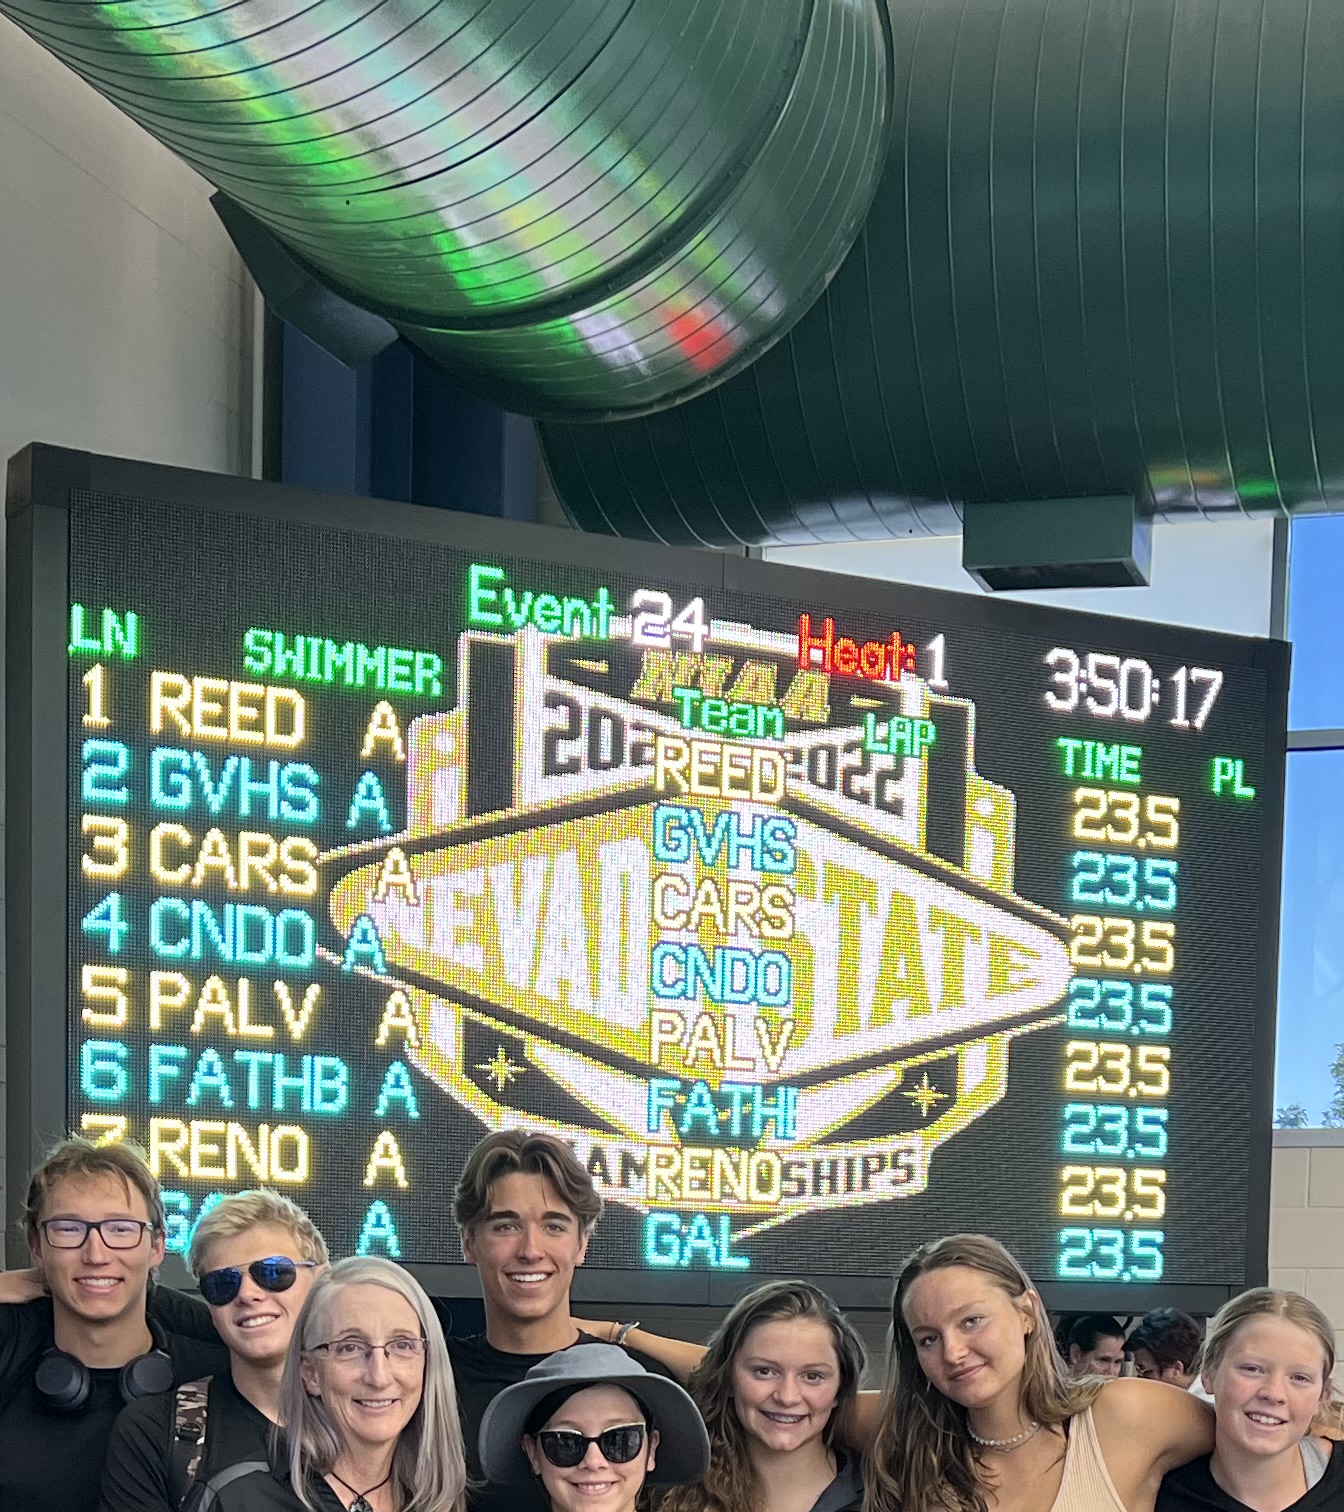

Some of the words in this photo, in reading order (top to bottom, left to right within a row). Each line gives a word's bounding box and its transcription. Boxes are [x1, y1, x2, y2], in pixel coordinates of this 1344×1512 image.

[68, 603, 139, 658] LN
[243, 627, 443, 697] SWIMMER
[468, 563, 614, 640] Event
[630, 588, 710, 653] 24
[925, 633, 950, 690] 1
[81, 663, 112, 729] 1
[149, 670, 307, 750] REED
[360, 700, 406, 761] A
[672, 686, 786, 740] Team
[863, 710, 937, 758] LAP
[81, 738, 131, 805] 2
[149, 746, 320, 824] GVHS
[346, 769, 392, 832] A
[655, 734, 787, 803] REED
[1056, 736, 1144, 786] TIME
[1210, 756, 1256, 800] PL
[653, 803, 798, 874] GVHS
[1071, 786, 1181, 850] 23.5
[81, 814, 129, 879] 3
[149, 822, 318, 897] CARS
[374, 847, 419, 905] A
[1069, 850, 1178, 911] 23.5
[81, 891, 129, 955] 4
[149, 896, 316, 969] CNDO
[341, 913, 387, 974] A
[652, 872, 797, 942] CARS
[651, 941, 793, 1006] CNDO
[1068, 914, 1175, 974] 23.5
[80, 964, 128, 1028] 5
[149, 969, 322, 1042] PALV
[375, 989, 421, 1049] A
[1067, 977, 1174, 1036] 23.5
[649, 1008, 797, 1073] PALV
[1064, 1040, 1171, 1098] 23.5
[80, 1038, 129, 1103] 6
[148, 1042, 349, 1115] FATHB
[375, 1059, 421, 1120] A
[149, 1117, 310, 1185] RENO
[362, 1130, 410, 1189] A
[1062, 1102, 1168, 1160] 23.5
[645, 1146, 783, 1203] RENO
[1060, 1165, 1167, 1222] 23.5
[356, 1199, 402, 1259] A
[644, 1211, 751, 1268] GAL
[1057, 1227, 1165, 1282] 23.5
